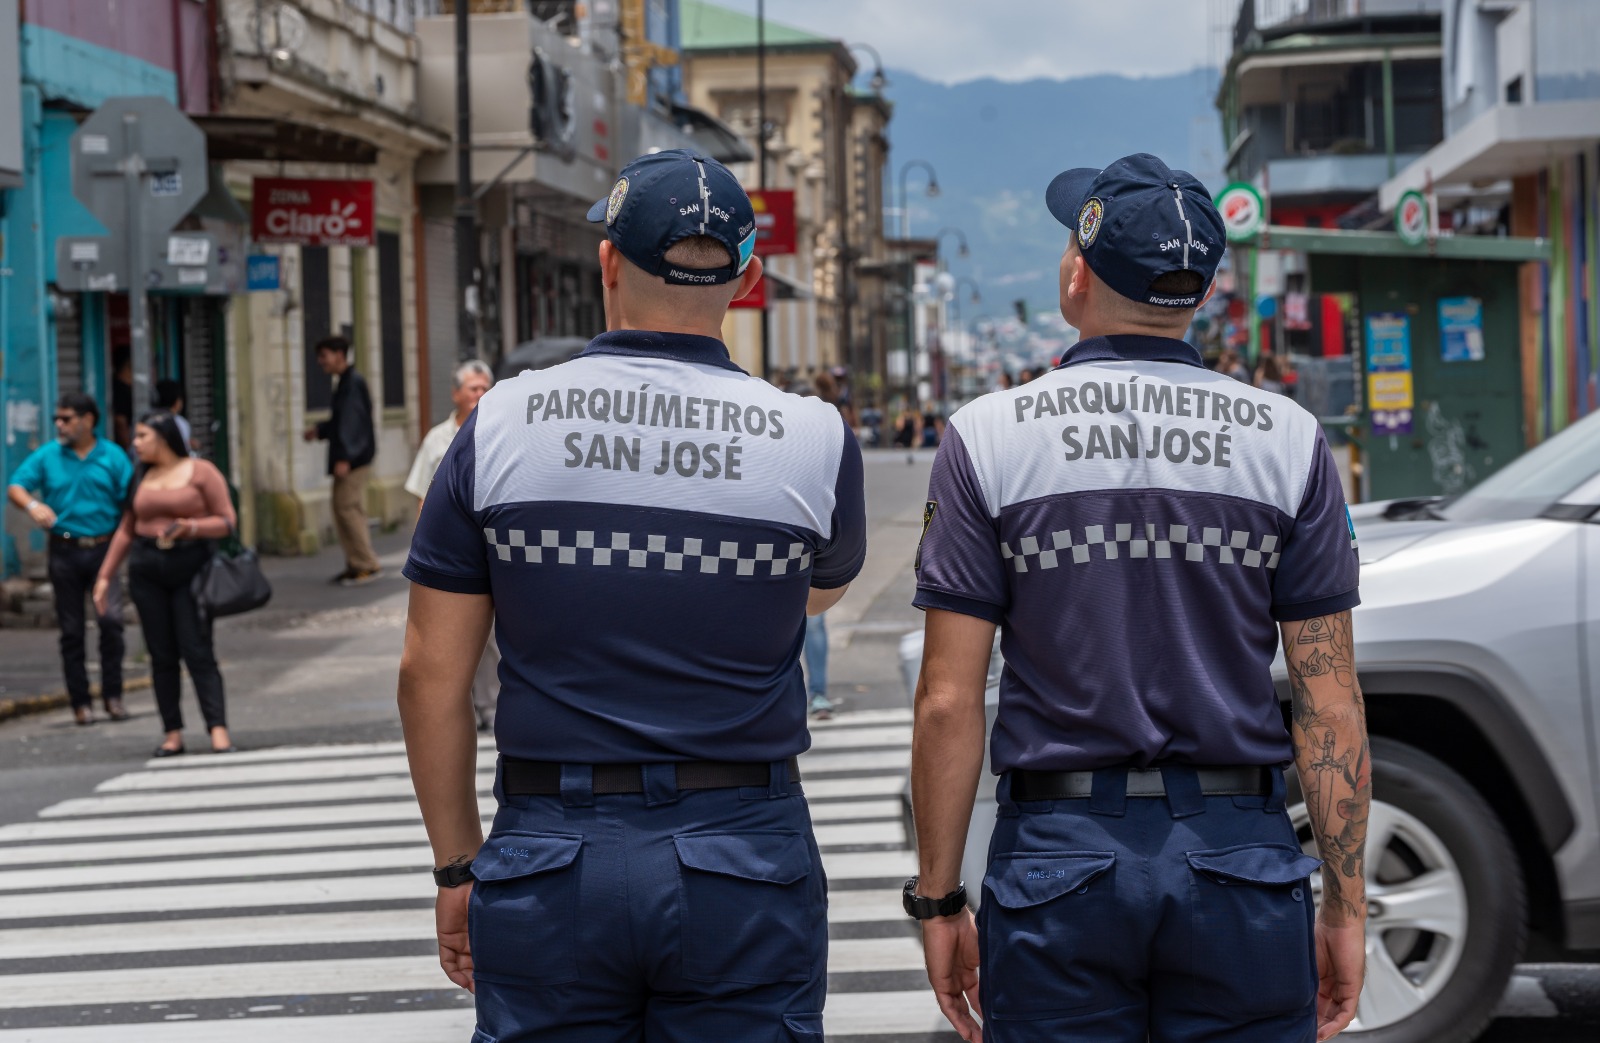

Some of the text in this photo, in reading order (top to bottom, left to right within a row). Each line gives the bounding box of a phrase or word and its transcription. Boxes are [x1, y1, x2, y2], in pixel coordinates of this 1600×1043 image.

[269, 188, 311, 205] ZONA
[266, 207, 346, 236] Claro
[679, 203, 730, 222] SAN JOSE
[1159, 238, 1208, 256] SAN JOSE
[669, 268, 717, 283] INSPECTOR
[1149, 295, 1196, 306] INSPECTOR
[526, 383, 785, 440] PARQUÍMETROS
[1014, 376, 1273, 432] PARQUÍMETROS
[564, 431, 743, 480] SAN JOSÉ
[1061, 423, 1232, 468] SAN JOSÉ
